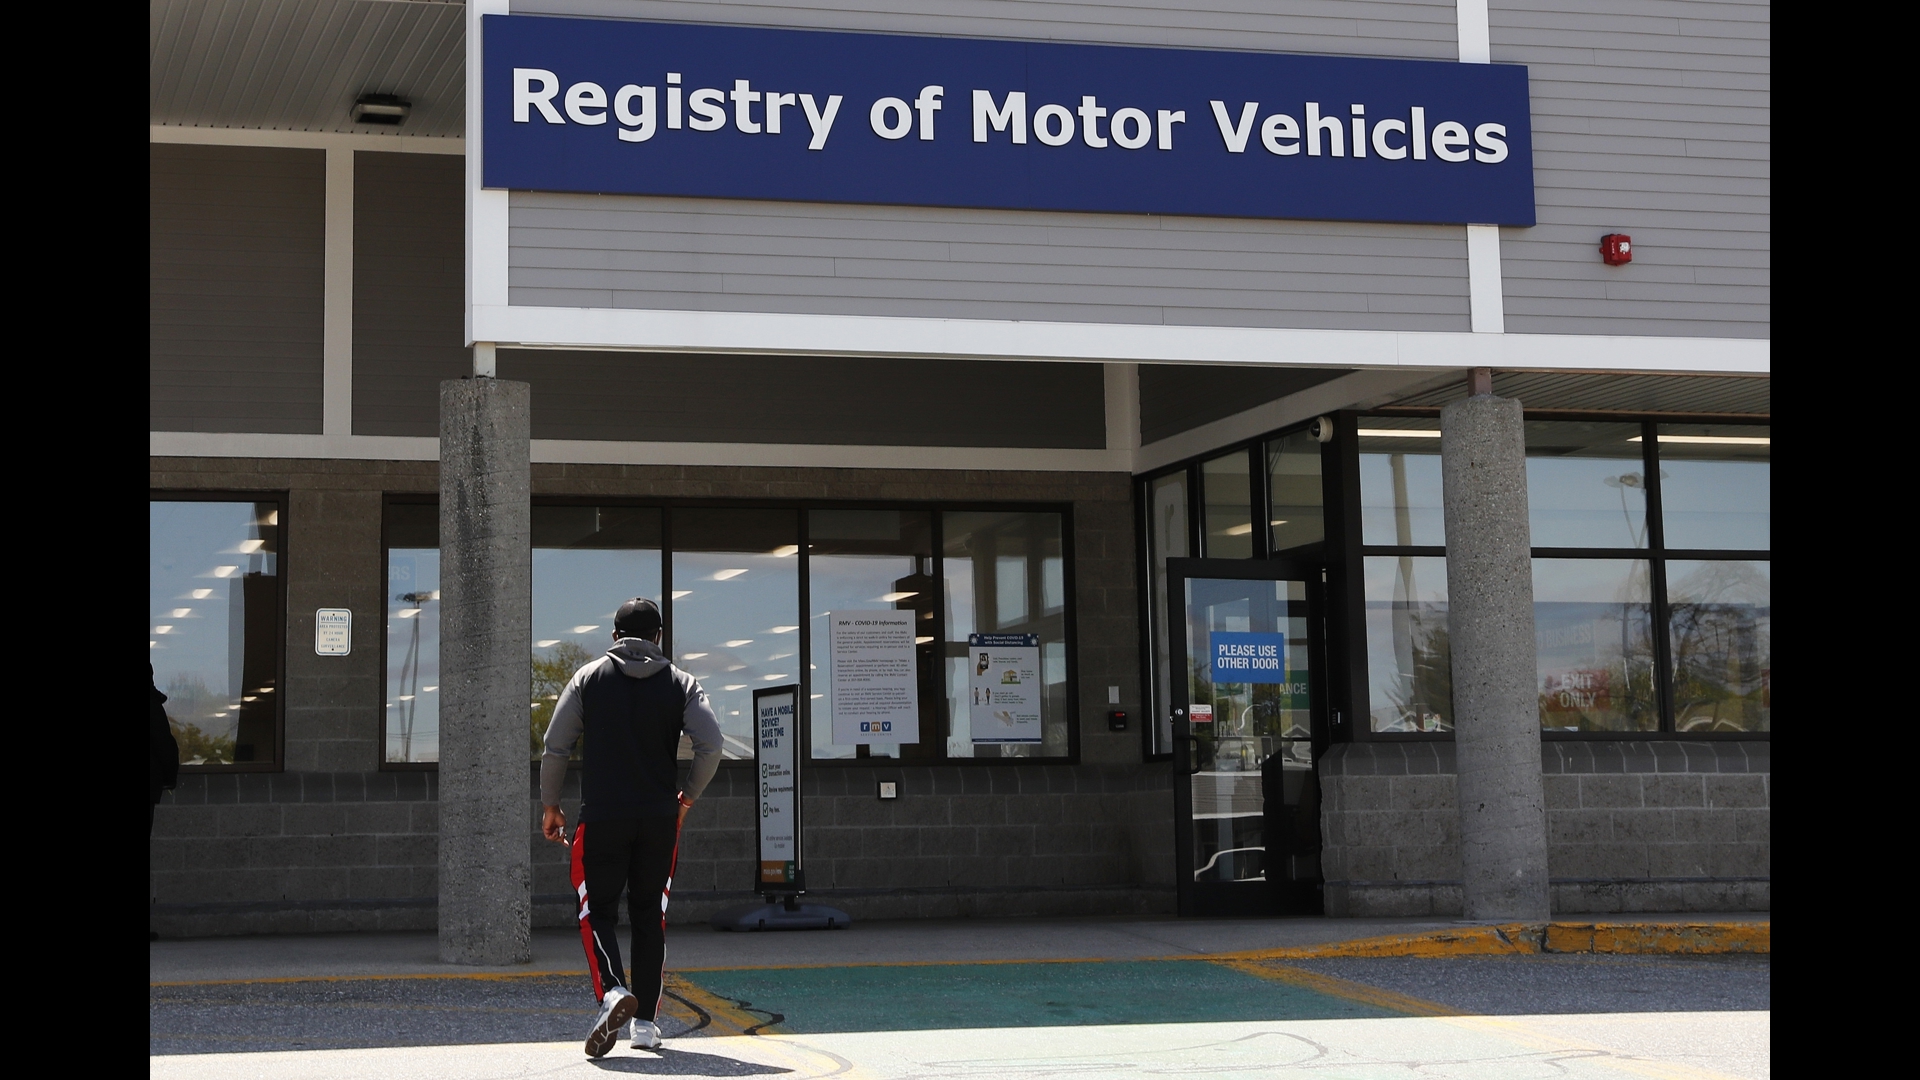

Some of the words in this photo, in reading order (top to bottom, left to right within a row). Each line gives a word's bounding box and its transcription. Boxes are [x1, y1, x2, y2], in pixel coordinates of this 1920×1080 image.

[511, 66, 844, 152] Registry
[868, 84, 945, 142] of
[971, 88, 1187, 151] Motor
[1209, 99, 1511, 165] Vehicles
[1218, 644, 1256, 657] PLEASE
[1258, 645, 1277, 657] USE
[1217, 657, 1250, 670] OTHER
[1252, 658, 1279, 670] DOOR
[1560, 673, 1593, 690] EXIT
[1559, 691, 1597, 708] ONLY
[761, 707, 774, 717] HAVE
[773, 706, 778, 716] A
[777, 704, 794, 716] MOBILE
[761, 717, 780, 728] DEVICE?
[761, 728, 774, 739] SAVE
[774, 727, 785, 737] TIME
